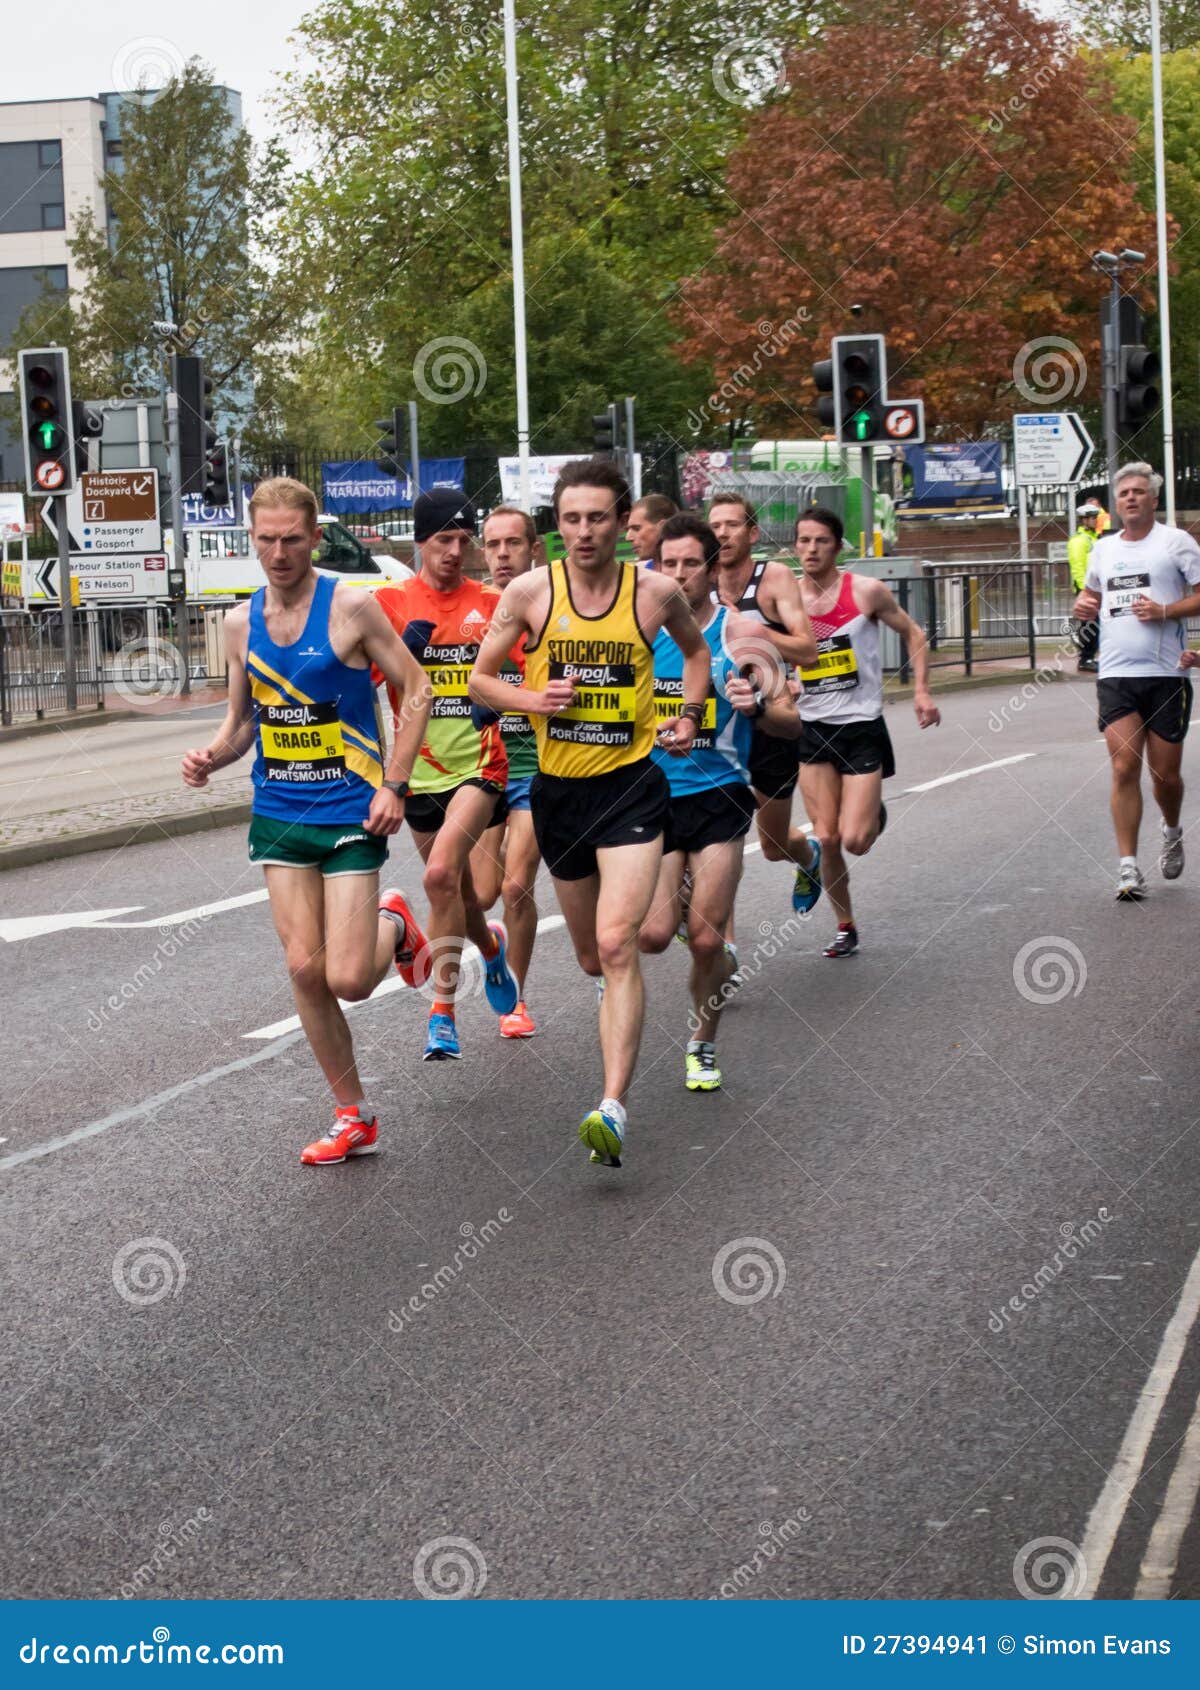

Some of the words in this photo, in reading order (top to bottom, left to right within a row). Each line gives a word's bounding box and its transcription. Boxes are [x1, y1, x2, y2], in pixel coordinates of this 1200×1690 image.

[88, 476, 127, 486] Historic
[85, 486, 132, 497] Dockyard
[326, 484, 397, 499] MARATHON
[94, 526, 144, 536] Passenger
[95, 539, 135, 549] Gosport
[70, 561, 101, 571] arbour
[105, 560, 141, 570] Station
[78, 581, 91, 590] MS
[94, 580, 129, 589] Nelson
[424, 645, 462, 662] Bupa
[547, 639, 635, 665] STOCKPORT
[429, 669, 473, 686] EATTI
[498, 671, 524, 687] upa
[563, 664, 605, 684] Bupa
[573, 692, 620, 710] ARTIN
[268, 706, 309, 724] Bupa
[430, 706, 472, 717] TSMOU
[272, 731, 323, 749] CRAGG
[549, 727, 630, 745] PORTSMOUTH
[325, 745, 337, 757] 15
[268, 767, 342, 782] PORTSMOUTH
